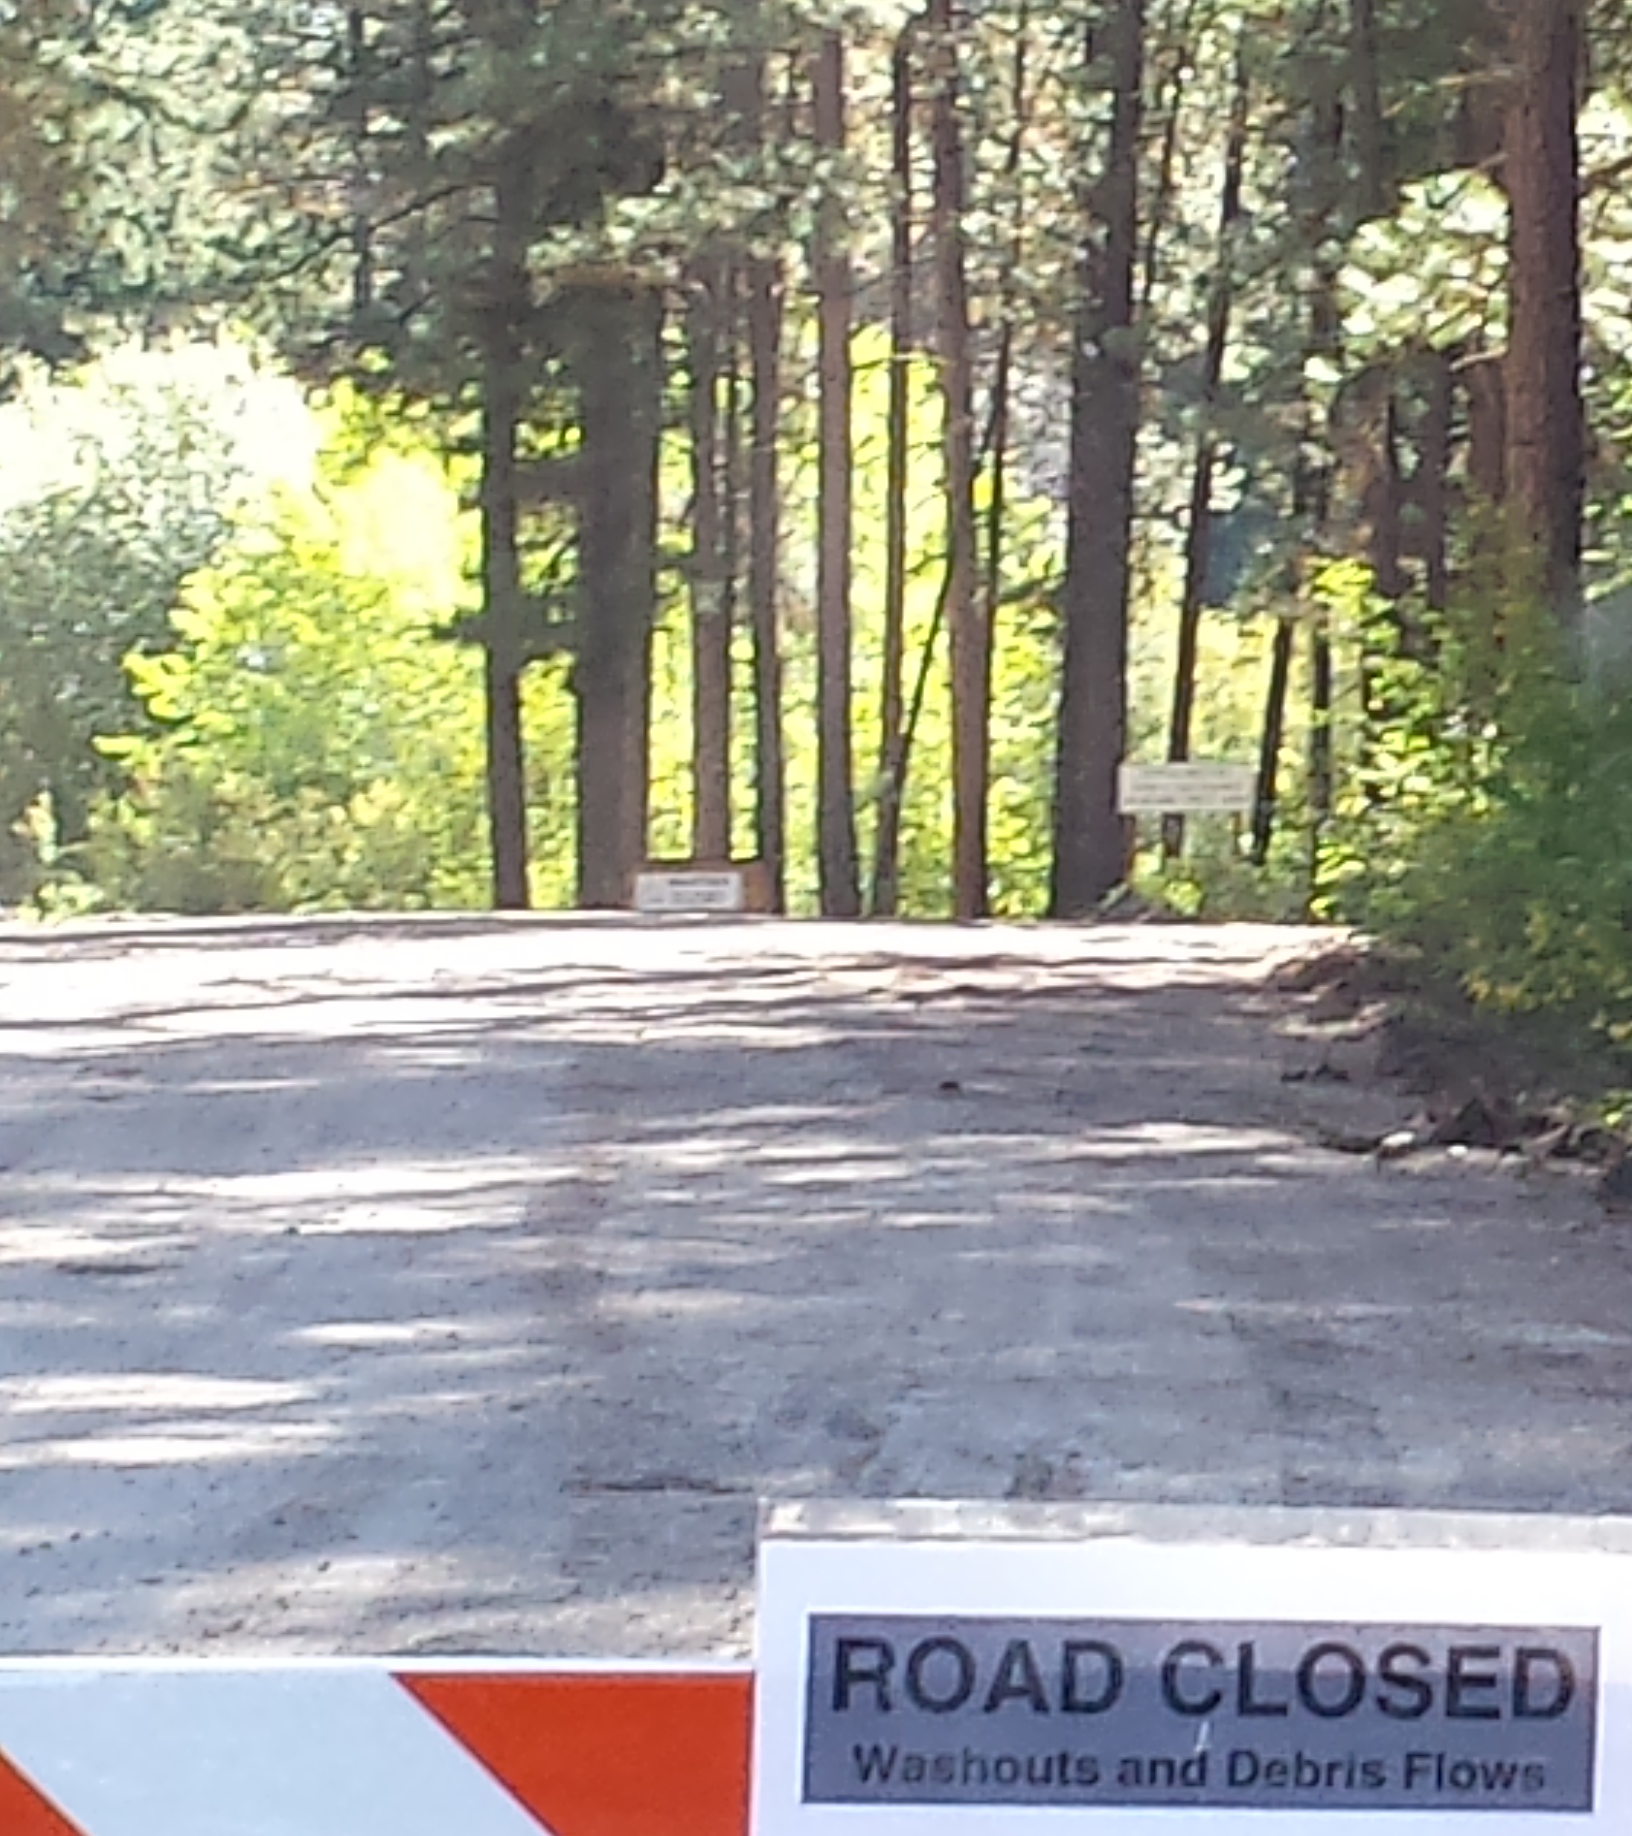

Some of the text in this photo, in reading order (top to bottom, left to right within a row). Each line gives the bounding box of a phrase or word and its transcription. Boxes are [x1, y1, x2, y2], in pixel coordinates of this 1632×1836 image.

[830, 1637, 1575, 1721] ROAD CLOSED
[852, 1745, 1546, 1794] Washouts and Debris Flows
